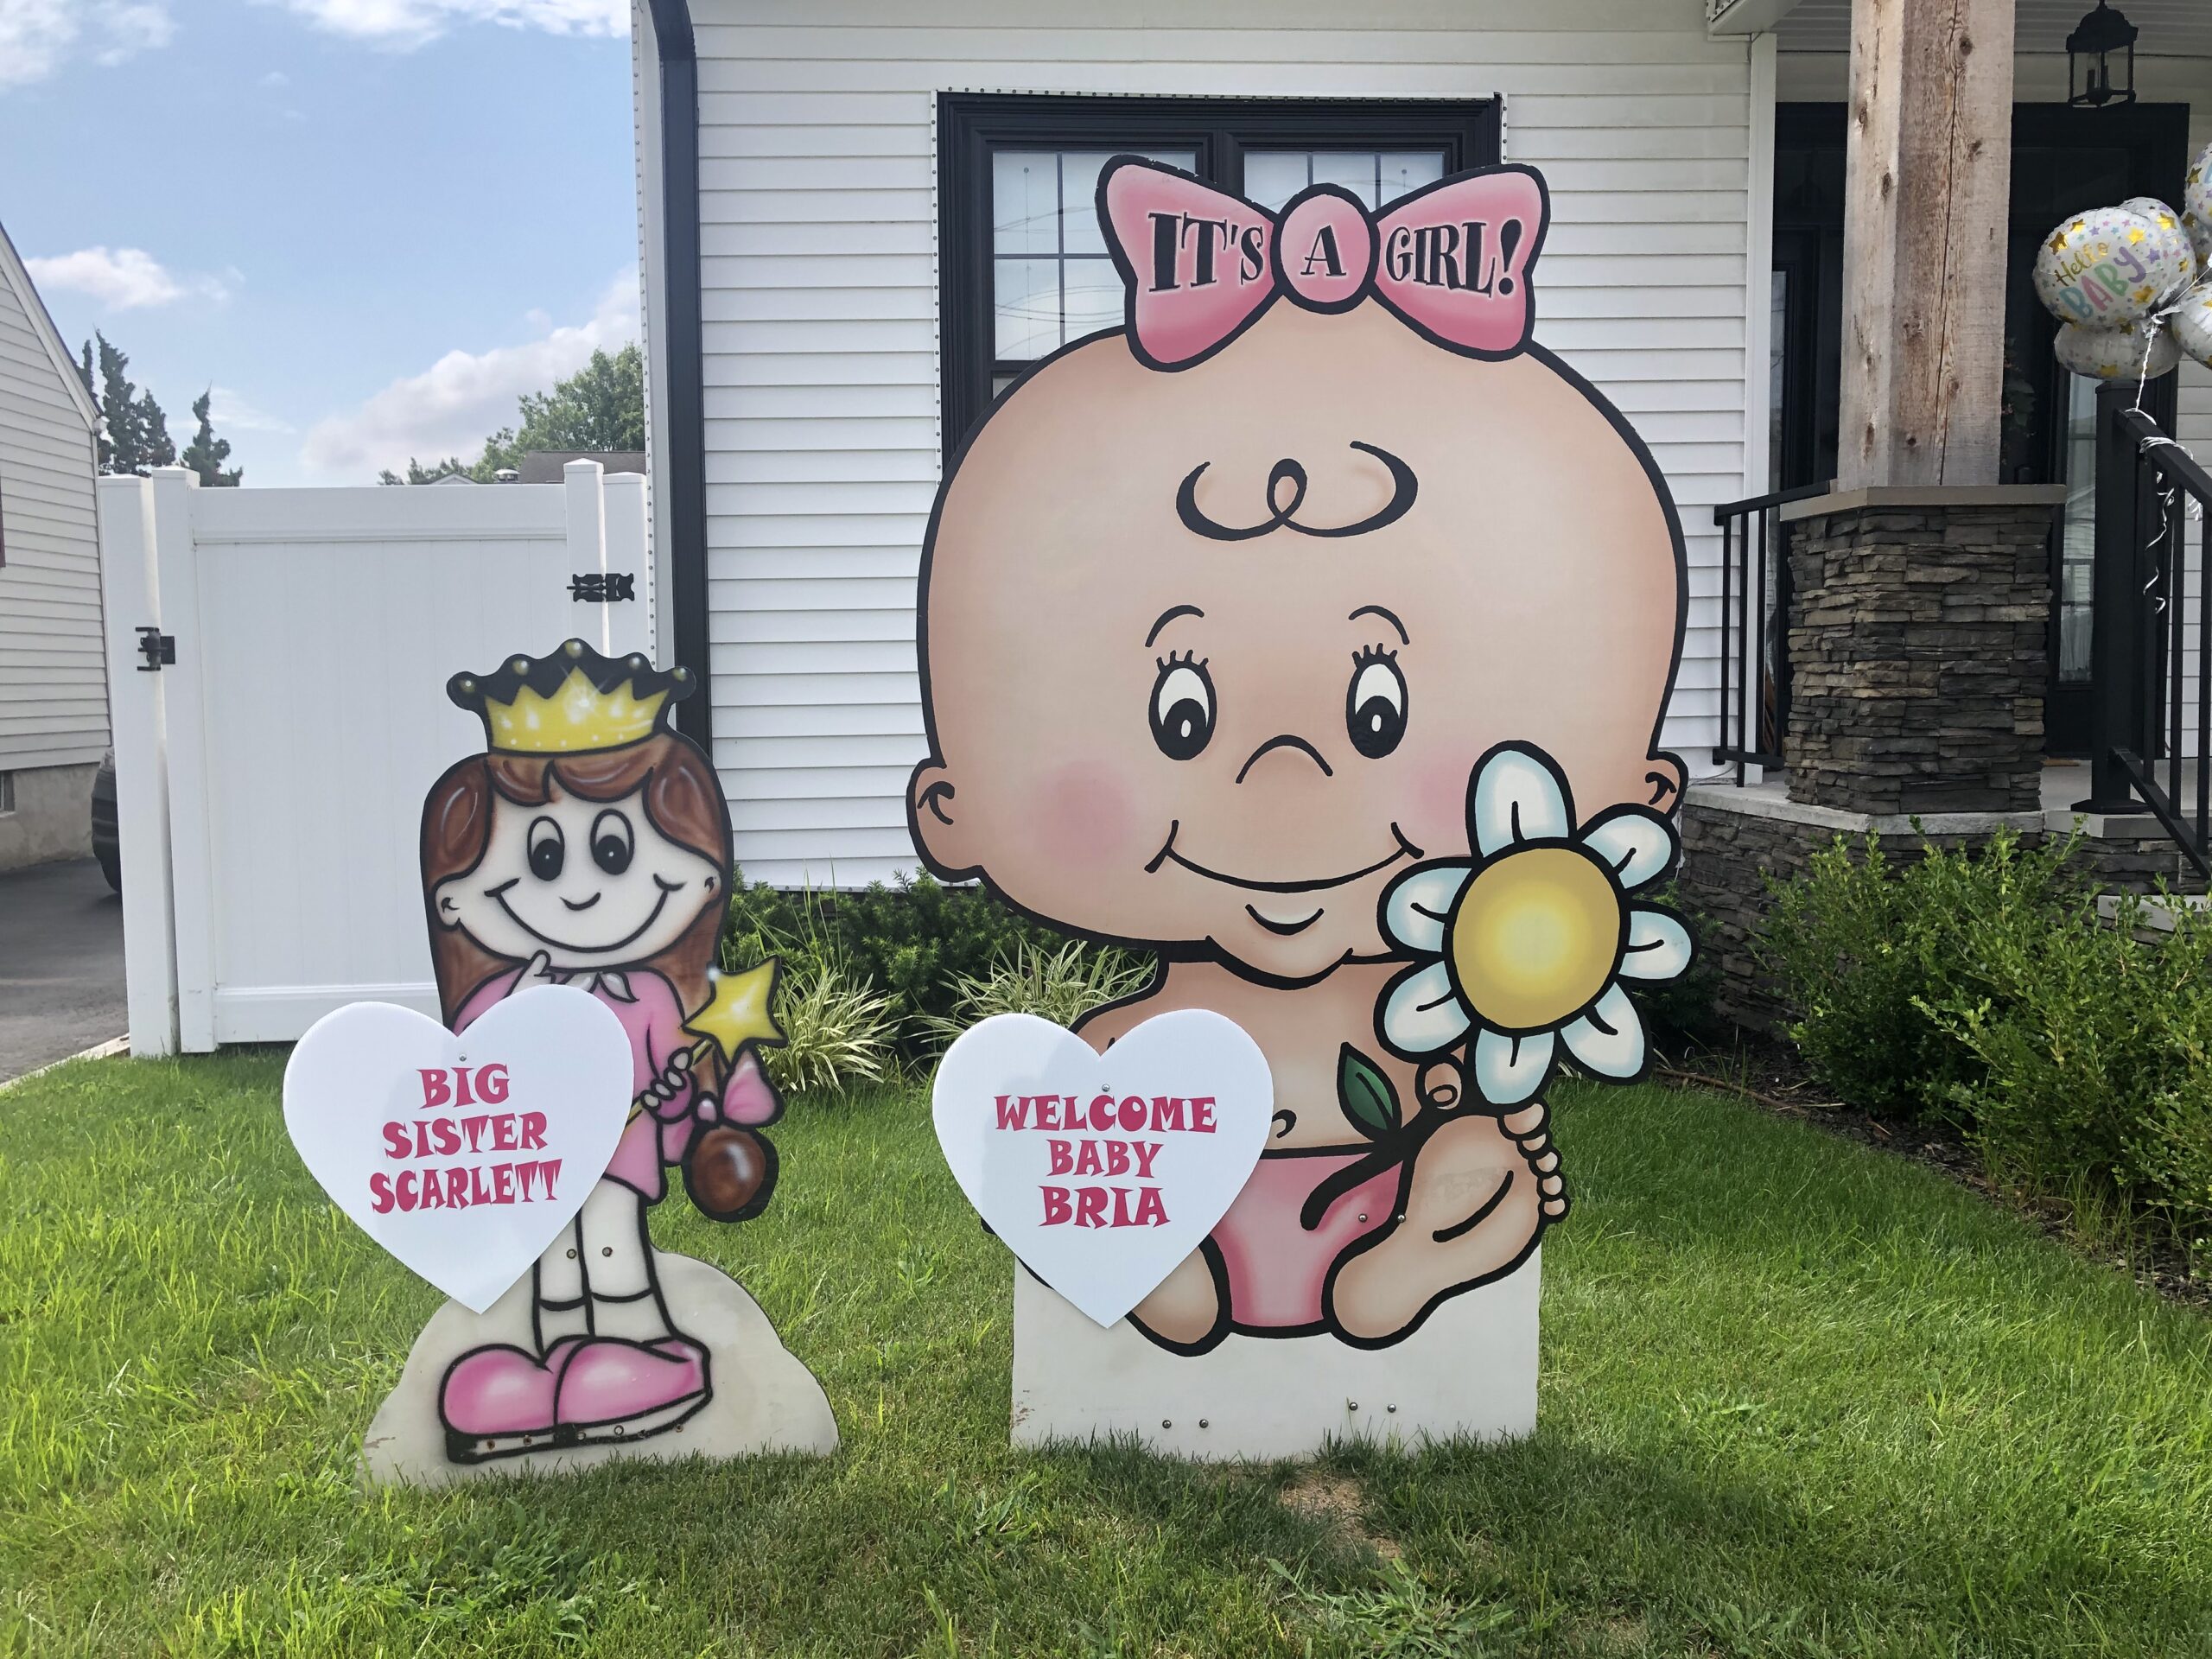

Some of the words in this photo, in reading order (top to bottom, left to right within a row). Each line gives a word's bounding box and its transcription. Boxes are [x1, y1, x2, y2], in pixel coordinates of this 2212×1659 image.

[1147, 212, 1266, 293] IT'S
[1300, 224, 1347, 276] A
[1385, 219, 1522, 298] GIRL!
[2055, 242, 2109, 286] Hello
[2059, 246, 2146, 319] BABY
[416, 1063, 510, 1109] BIG
[382, 1111, 549, 1160] SISTER
[994, 1094, 1217, 1134] WELCOME
[1046, 1139, 1164, 1179] BABY
[370, 1159, 563, 1214] SCARLETT
[1038, 1185, 1171, 1230] BRIA
